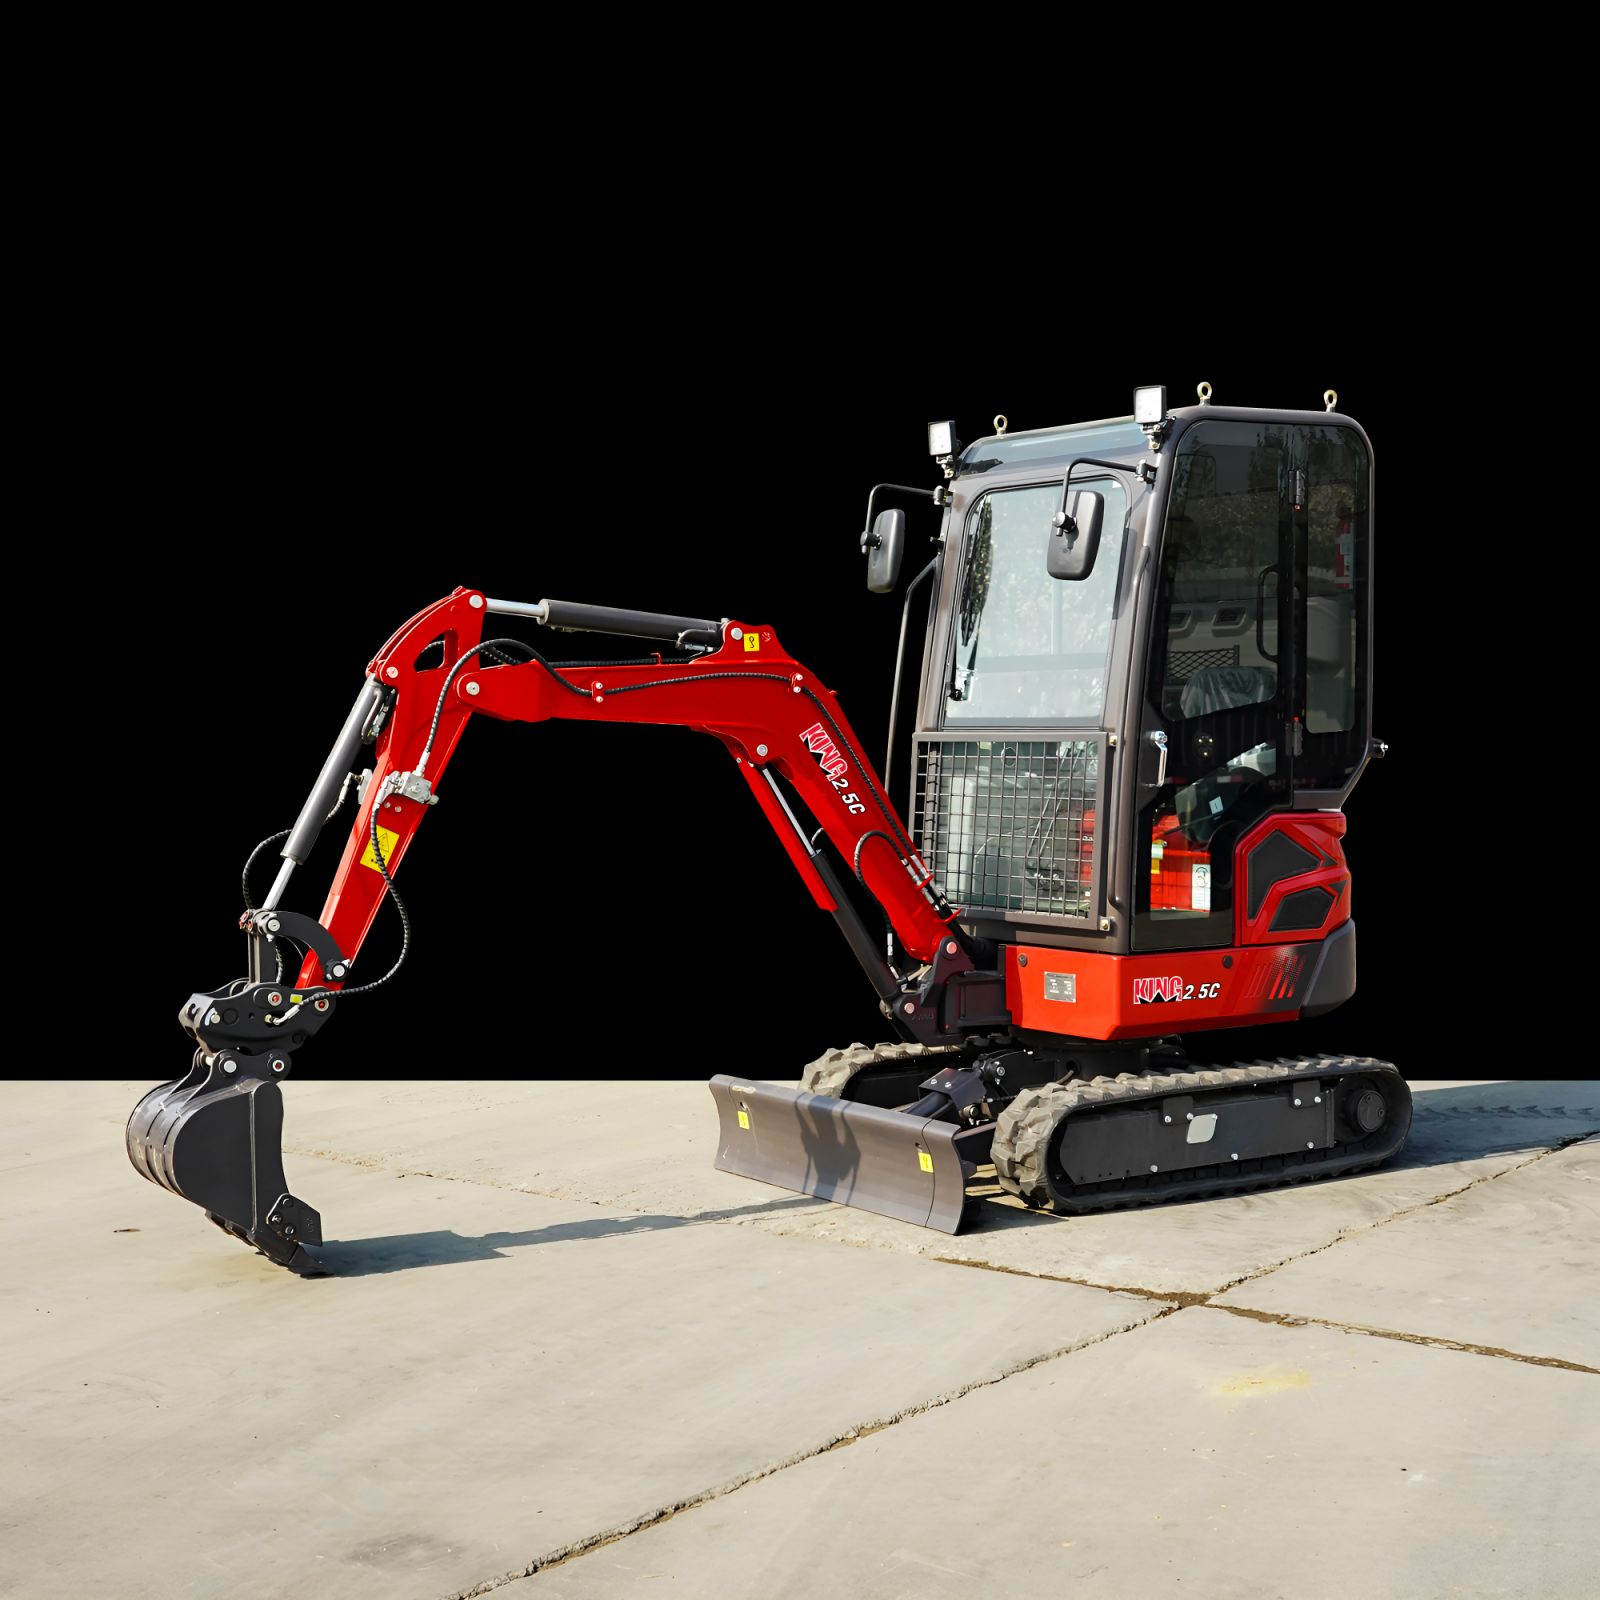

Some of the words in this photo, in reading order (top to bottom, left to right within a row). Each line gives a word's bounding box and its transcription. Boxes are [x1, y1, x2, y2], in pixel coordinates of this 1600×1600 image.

[799, 722, 848, 782] KING
[831, 778, 866, 815] 2.5C
[1133, 976, 1183, 1005] KING
[1182, 982, 1221, 1000] 2.5C
